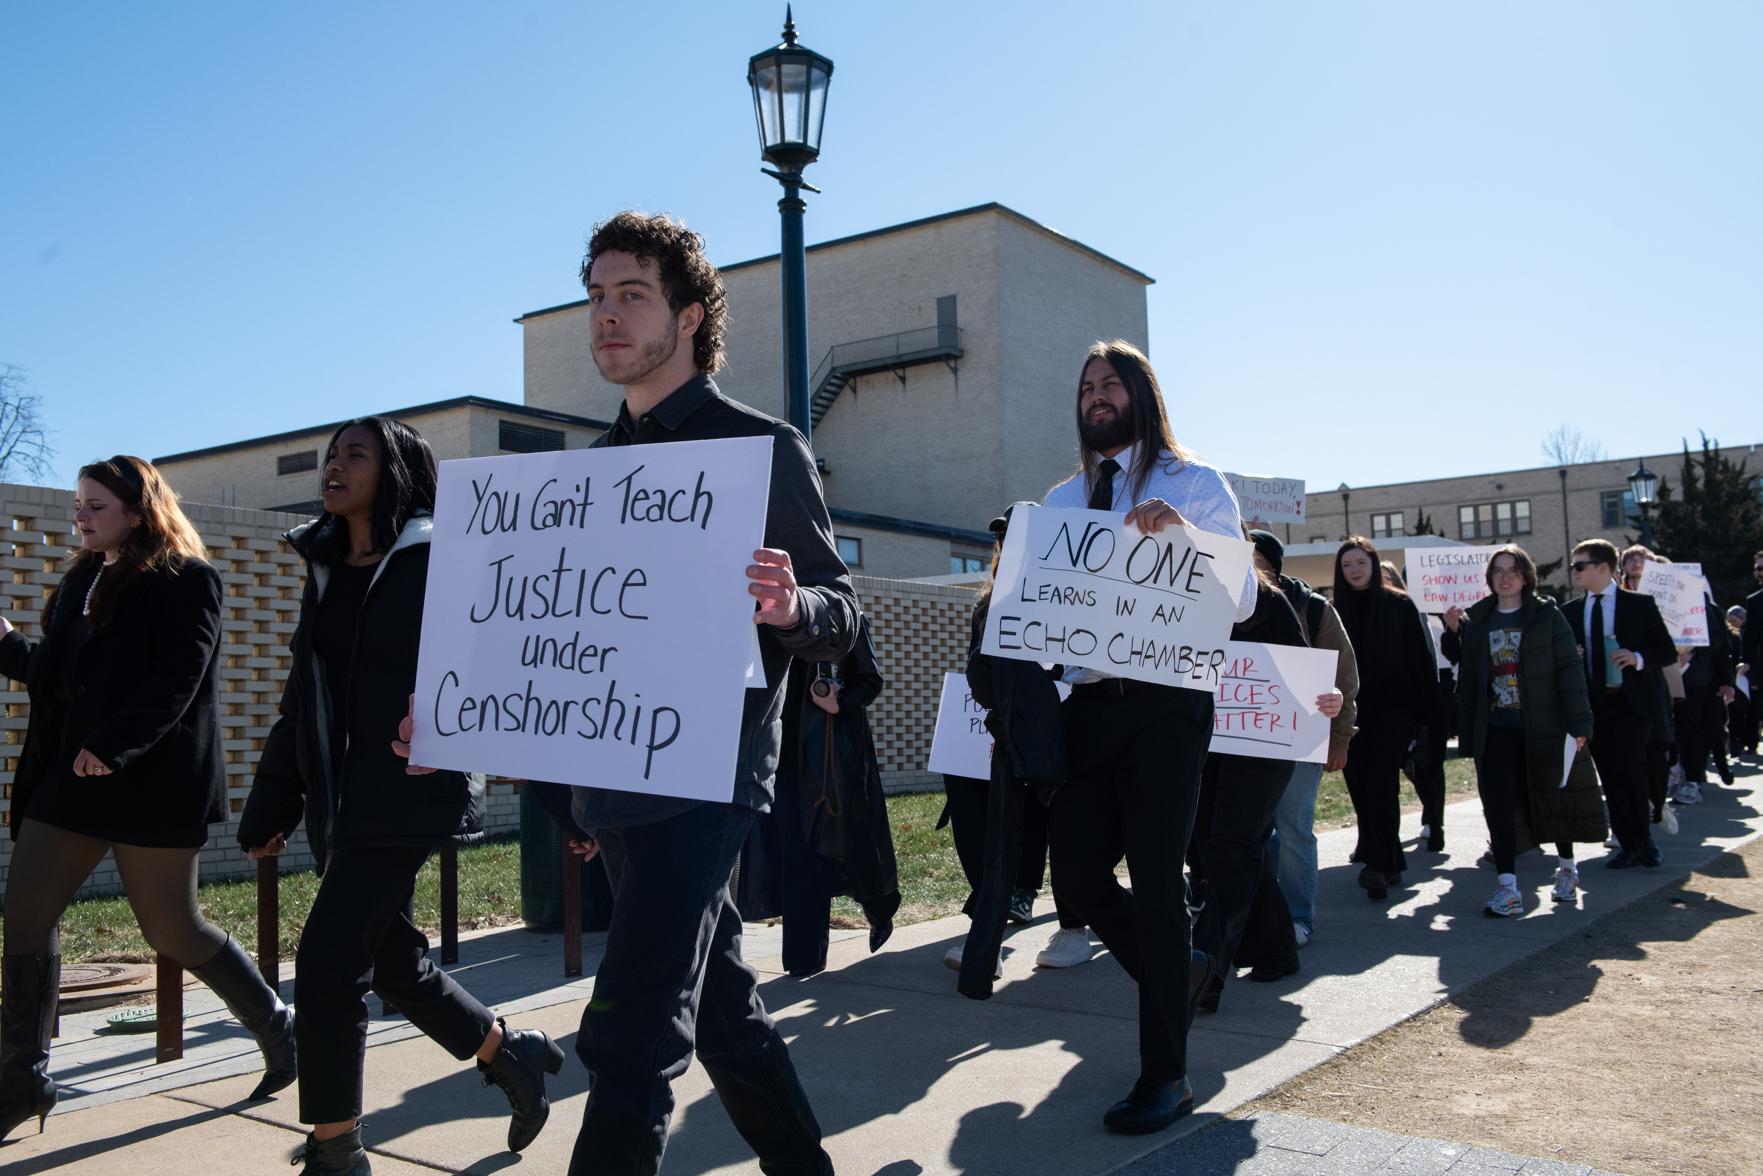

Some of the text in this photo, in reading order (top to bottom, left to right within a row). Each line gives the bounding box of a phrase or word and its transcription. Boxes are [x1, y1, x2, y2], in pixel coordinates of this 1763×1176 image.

[466, 465, 713, 535] You Can't Teach
[1038, 521, 1215, 594] NO ONE
[1422, 574, 1457, 585] SHOW
[1464, 573, 1479, 584] US
[470, 547, 649, 624] Justice
[1021, 577, 1185, 626] LEARNS IN AN
[1424, 592, 1448, 602] LAW
[521, 631, 618, 674] under
[999, 616, 1225, 687] ECHO CHAMBER
[1224, 657, 1258, 678] UR
[1216, 683, 1280, 705] ICES
[434, 670, 681, 780] Censhorship
